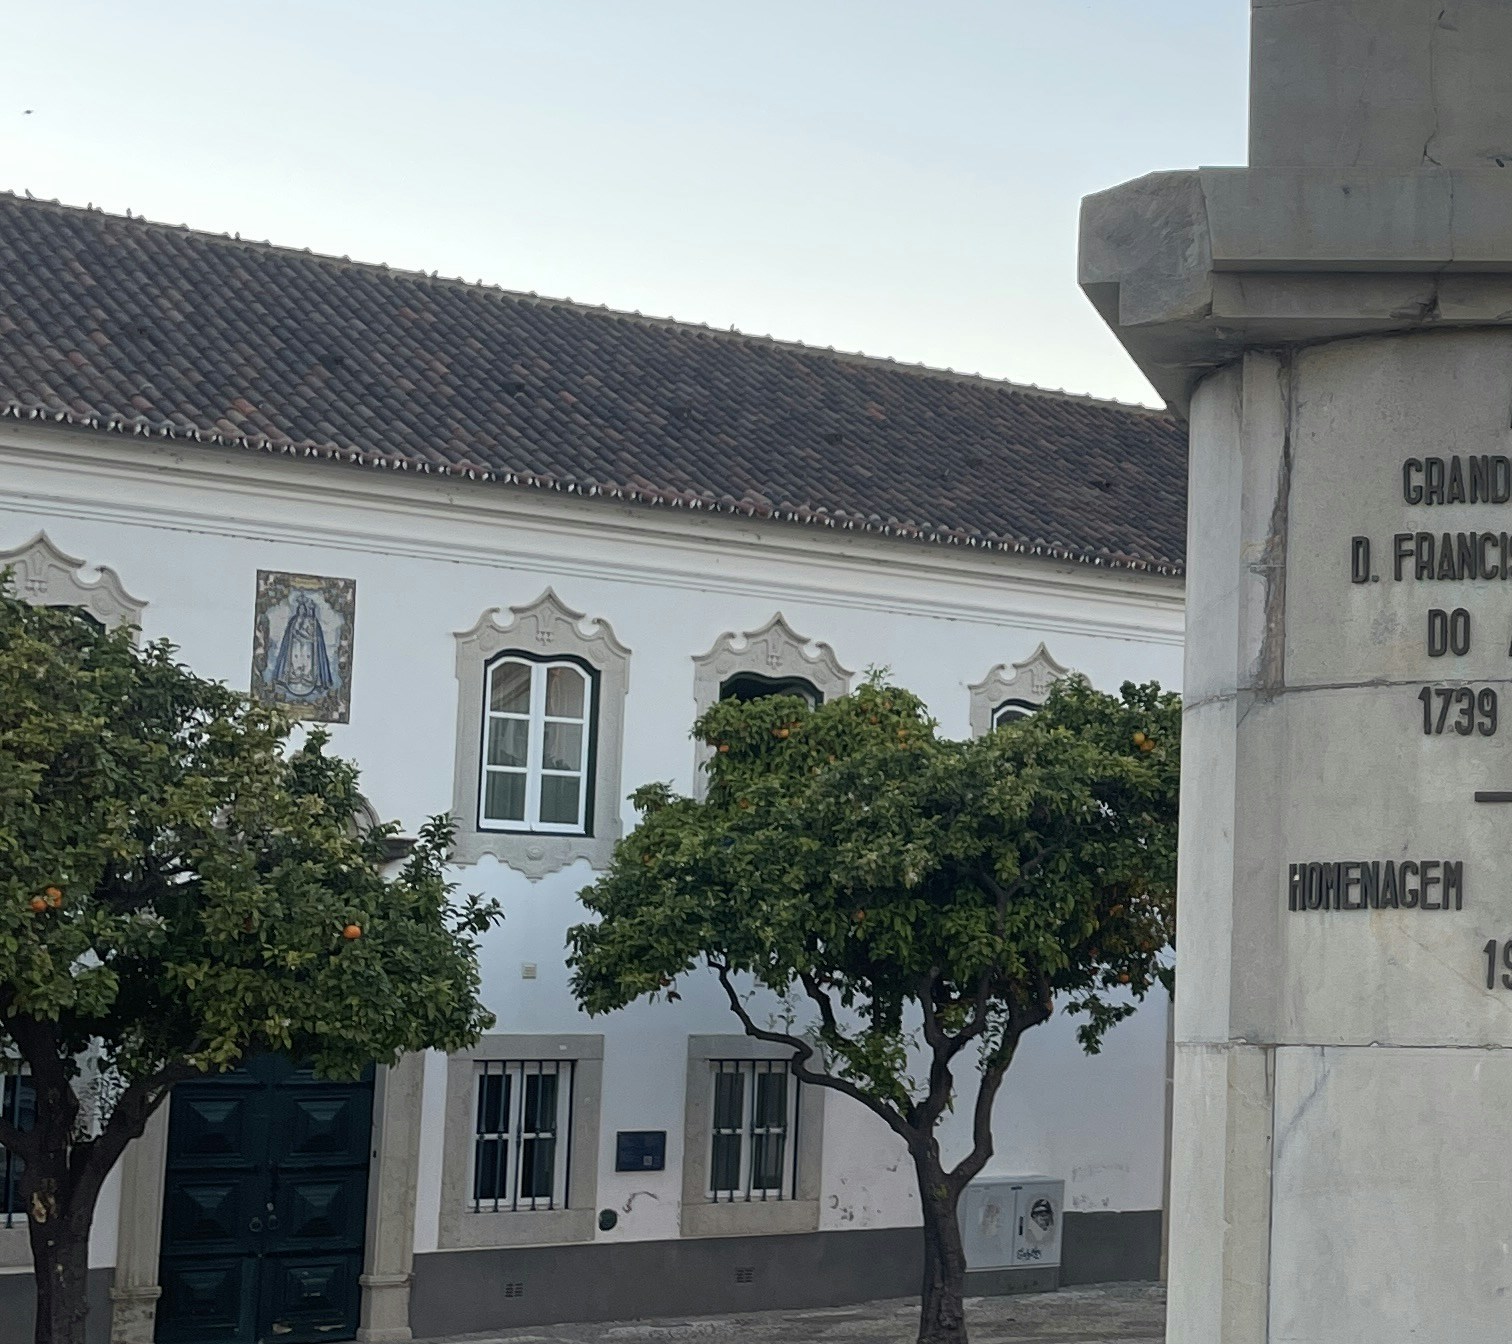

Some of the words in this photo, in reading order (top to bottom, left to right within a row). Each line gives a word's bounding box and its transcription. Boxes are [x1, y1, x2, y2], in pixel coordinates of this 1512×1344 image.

[1352, 536, 1379, 583] D.
[1428, 609, 1470, 657] DO
[1418, 687, 1497, 736] 1739
[1289, 861, 1463, 910] HOMENAGEM
